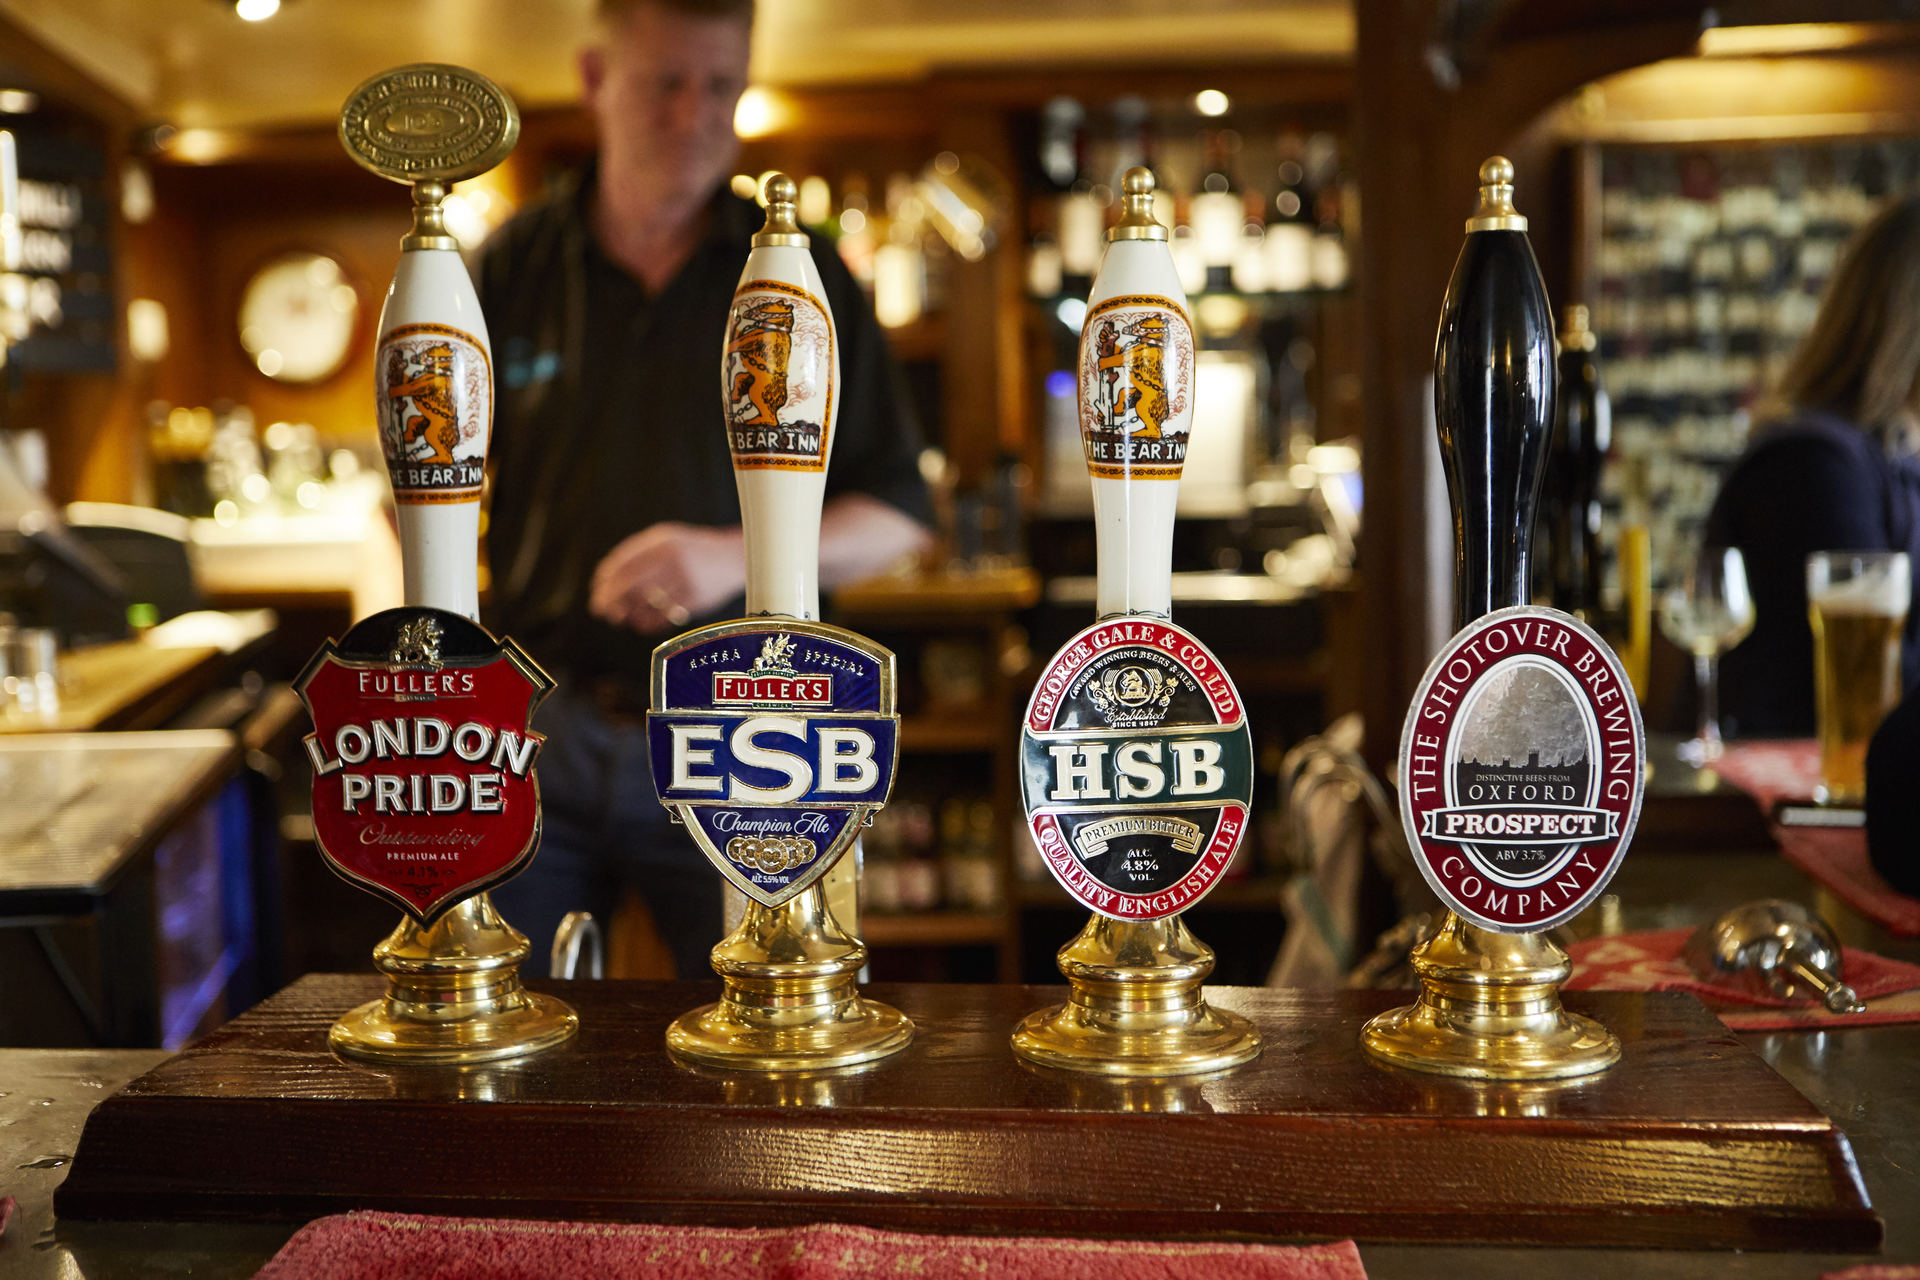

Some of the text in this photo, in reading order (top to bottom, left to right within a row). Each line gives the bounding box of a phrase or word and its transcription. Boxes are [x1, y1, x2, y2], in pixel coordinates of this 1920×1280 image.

[736, 431, 779, 449] BEAR
[786, 432, 818, 452] INN
[1087, 440, 1108, 459] THE
[1114, 442, 1160, 459] BEAR
[408, 469, 454, 486] BEAR
[460, 466, 482, 484] INN
[689, 648, 864, 677] EXTRA SPECIAL
[1034, 641, 1093, 722] GEORGE
[1092, 624, 1155, 648] GALE
[1159, 632, 1176, 649] &
[1205, 673, 1234, 714] LTD
[360, 671, 474, 694] FULLER'S
[1071, 666, 1095, 697] AWARD
[1095, 650, 1137, 669] WINNING
[1139, 650, 1170, 667] BEERS
[1177, 670, 1197, 692] ALES
[722, 679, 823, 700] FULLER'S
[1106, 706, 1168, 722] Established
[1414, 622, 1632, 801] THE SHOTOVER BREWING
[1112, 720, 1137, 728] SINCE
[305, 716, 540, 777] LONDON
[667, 717, 880, 804] ESB
[1049, 740, 1225, 801] HSB
[1476, 774, 1570, 782] DISTINCTIVE BEERS FROM
[342, 773, 504, 814] PRIDE
[1469, 785, 1576, 800] OXFORD
[712, 811, 830, 839] Champion Ale
[1085, 819, 1194, 841] PREMIUM BITTER
[1445, 814, 1596, 834] PROSPECT
[360, 822, 486, 850] Outstanding
[387, 852, 459, 861] PREMIUM ALE
[1121, 860, 1159, 871] 4.8%
[1496, 850, 1546, 860] ABV 3.7%
[408, 866, 439, 878] 4.1%
[1039, 819, 1239, 914] QUALITY ENGLISH ALE
[1129, 873, 1154, 881] VOL.
[751, 874, 790, 884] ALC 5.5% VOL
[1441, 852, 1598, 915] COMPANY
